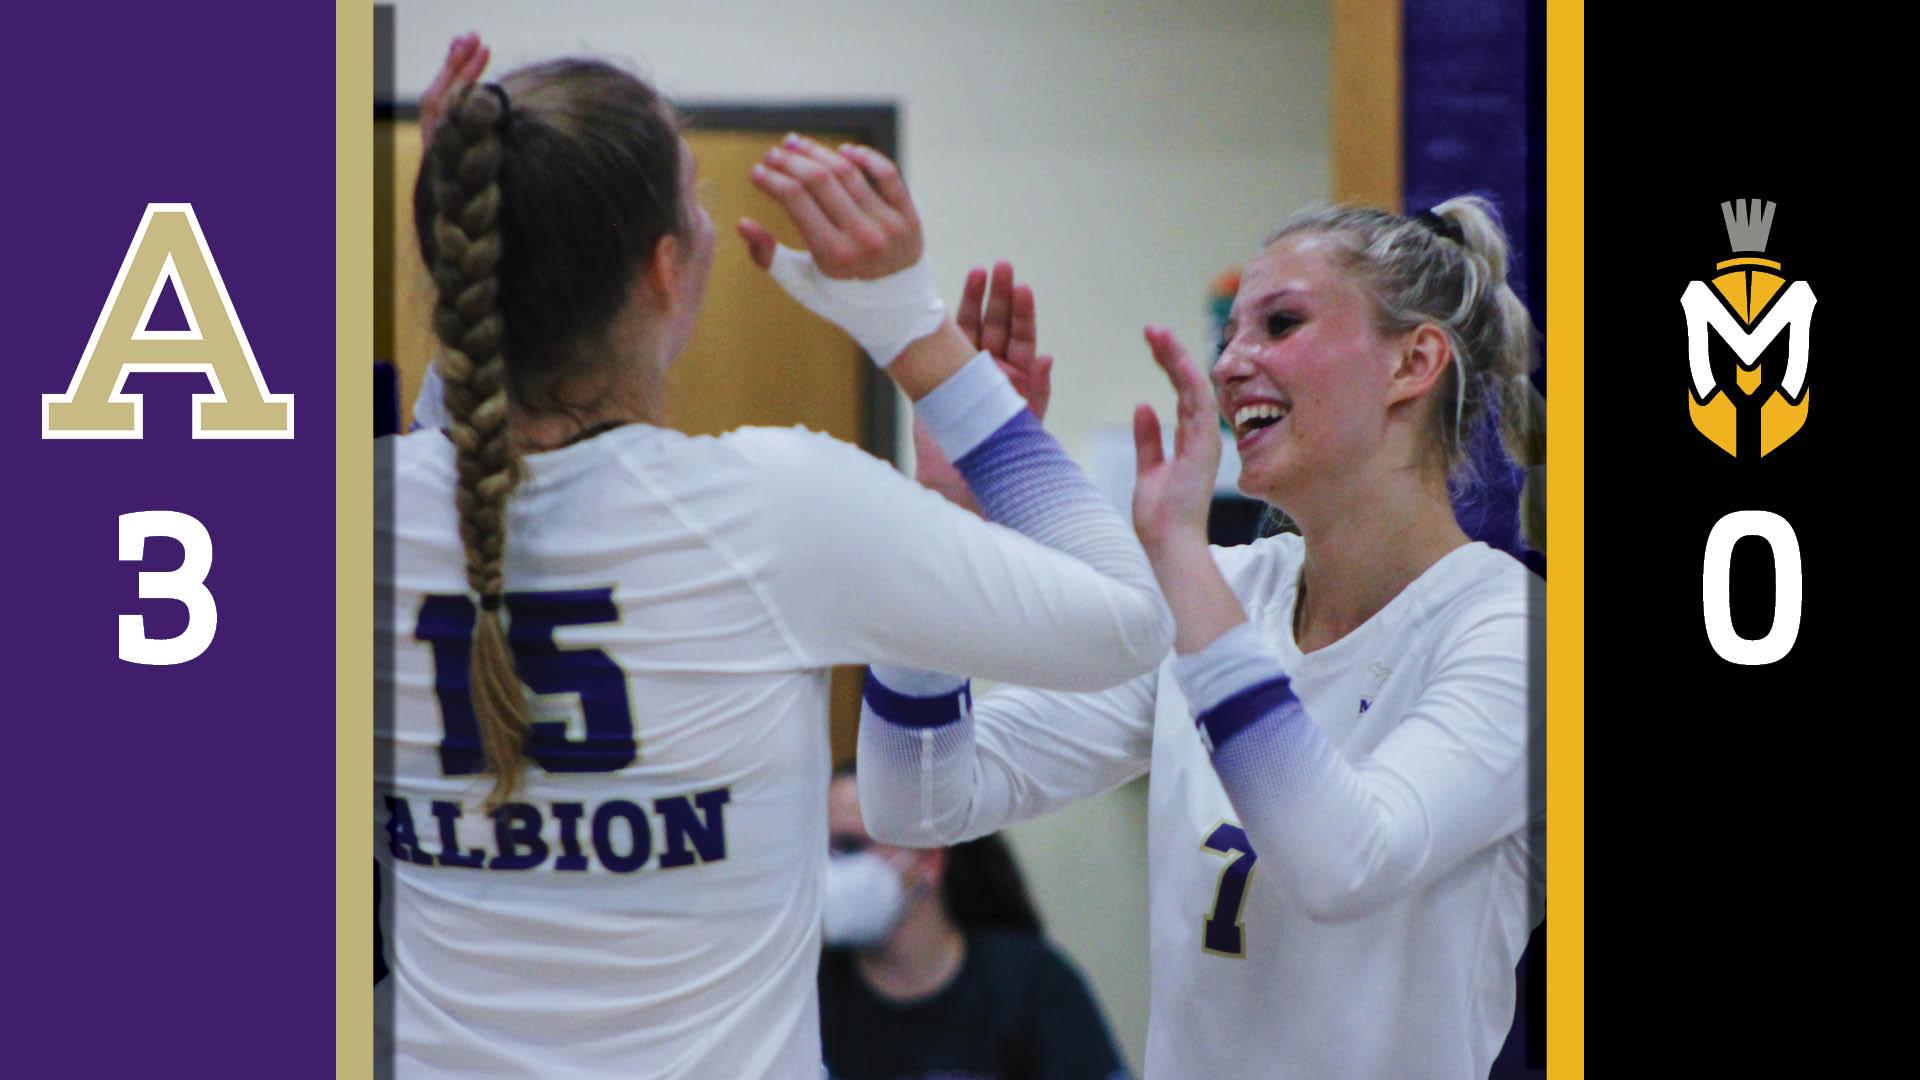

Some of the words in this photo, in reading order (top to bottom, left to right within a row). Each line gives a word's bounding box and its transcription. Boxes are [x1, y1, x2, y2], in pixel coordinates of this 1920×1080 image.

[412, 584, 640, 778] 15
[384, 784, 732, 873] ALBION
[1200, 817, 1258, 960] 7
